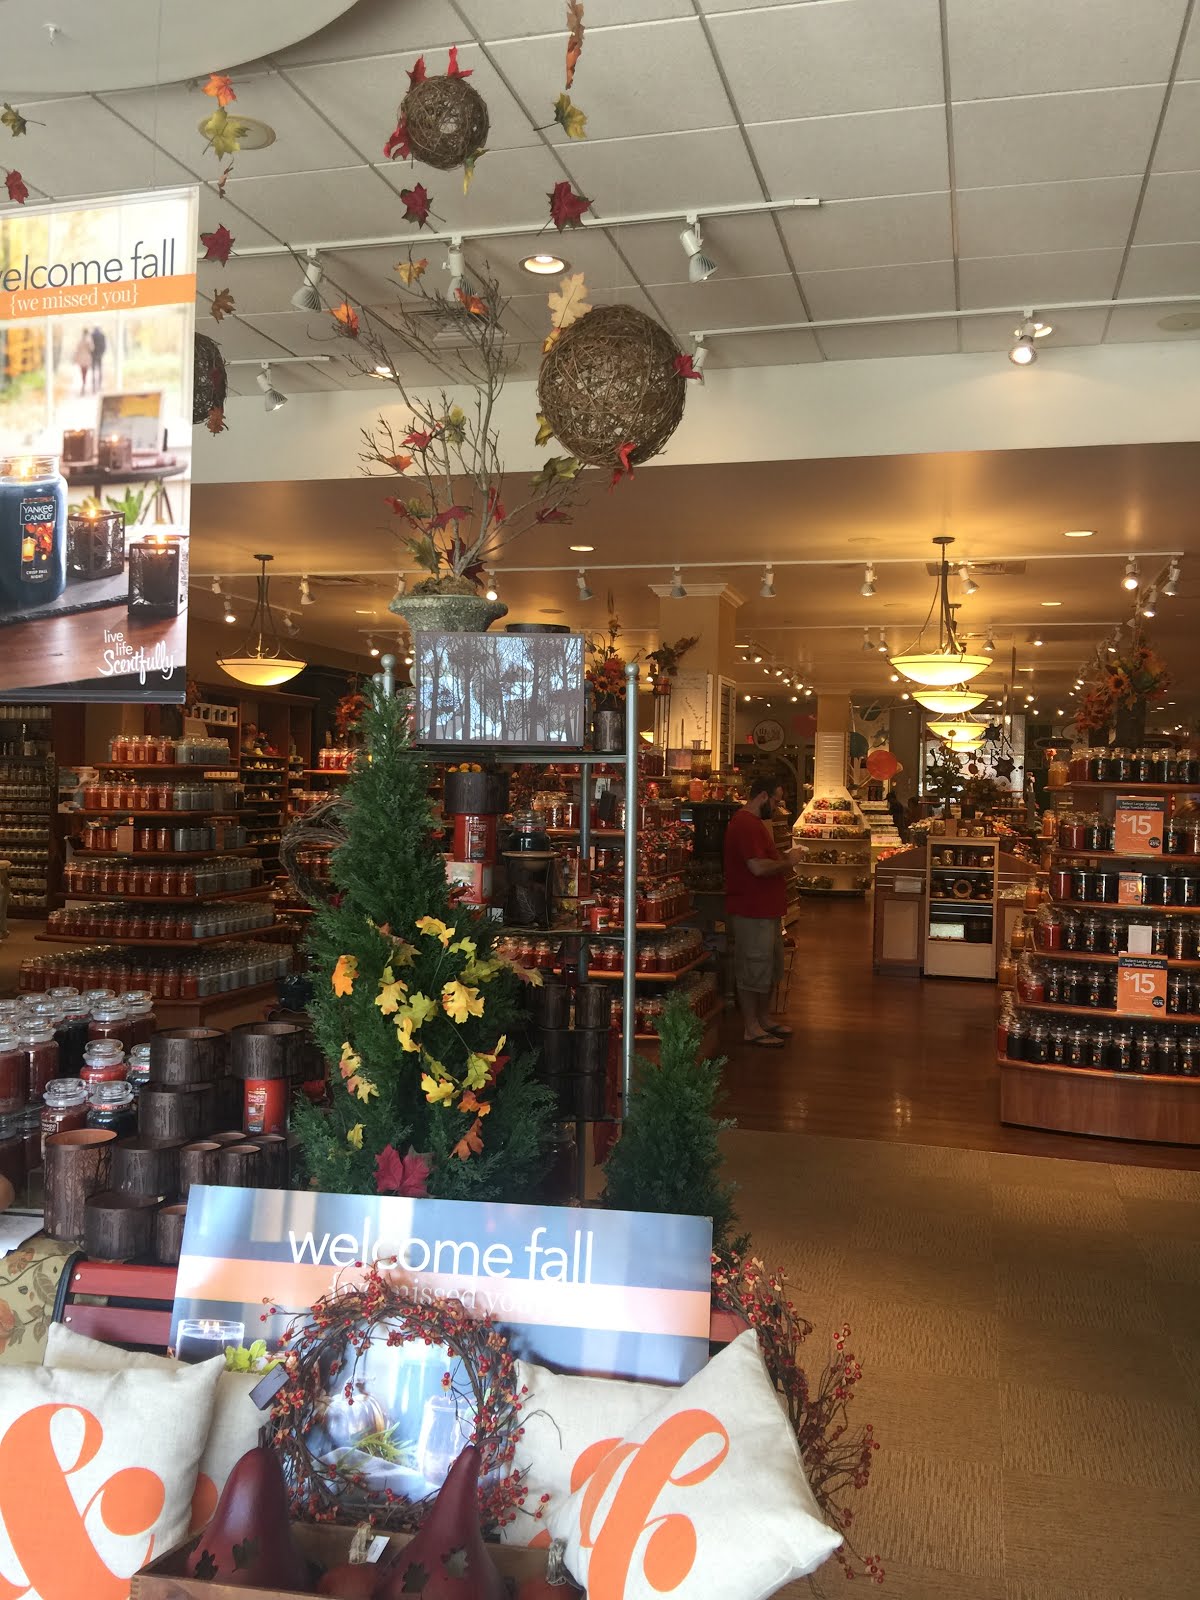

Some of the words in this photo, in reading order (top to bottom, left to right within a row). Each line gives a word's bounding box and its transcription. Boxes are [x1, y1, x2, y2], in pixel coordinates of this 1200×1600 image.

[0, 255, 123, 292] elcome
[131, 238, 175, 280] fall
[42, 287, 98, 310] missed
[104, 630, 123, 643] live
[116, 641, 133, 656] life
[1121, 813, 1152, 835] $15
[1123, 971, 1155, 994] $15
[288, 1216, 514, 1278] welcome
[524, 1227, 594, 1285] fall
